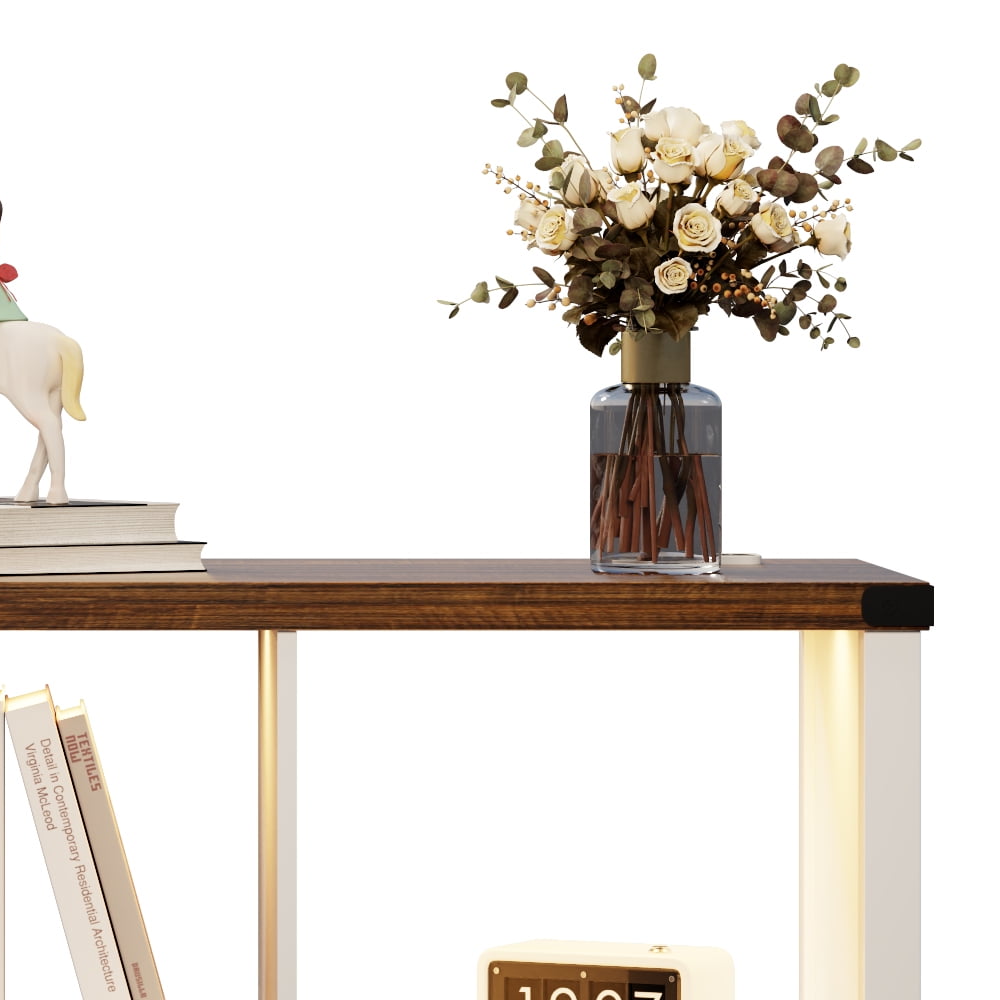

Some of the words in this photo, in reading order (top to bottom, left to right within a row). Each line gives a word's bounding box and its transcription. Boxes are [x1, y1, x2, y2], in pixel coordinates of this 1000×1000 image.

[40, 738, 58, 770] Detail
[50, 772, 59, 783] in
[77, 732, 102, 792] TEXTILES
[25, 742, 42, 785] Virginia
[36, 786, 57, 831] McLeod
[53, 785, 80, 861] Contemporary
[75, 864, 100, 925] Residential
[92, 928, 116, 993] Architecture
